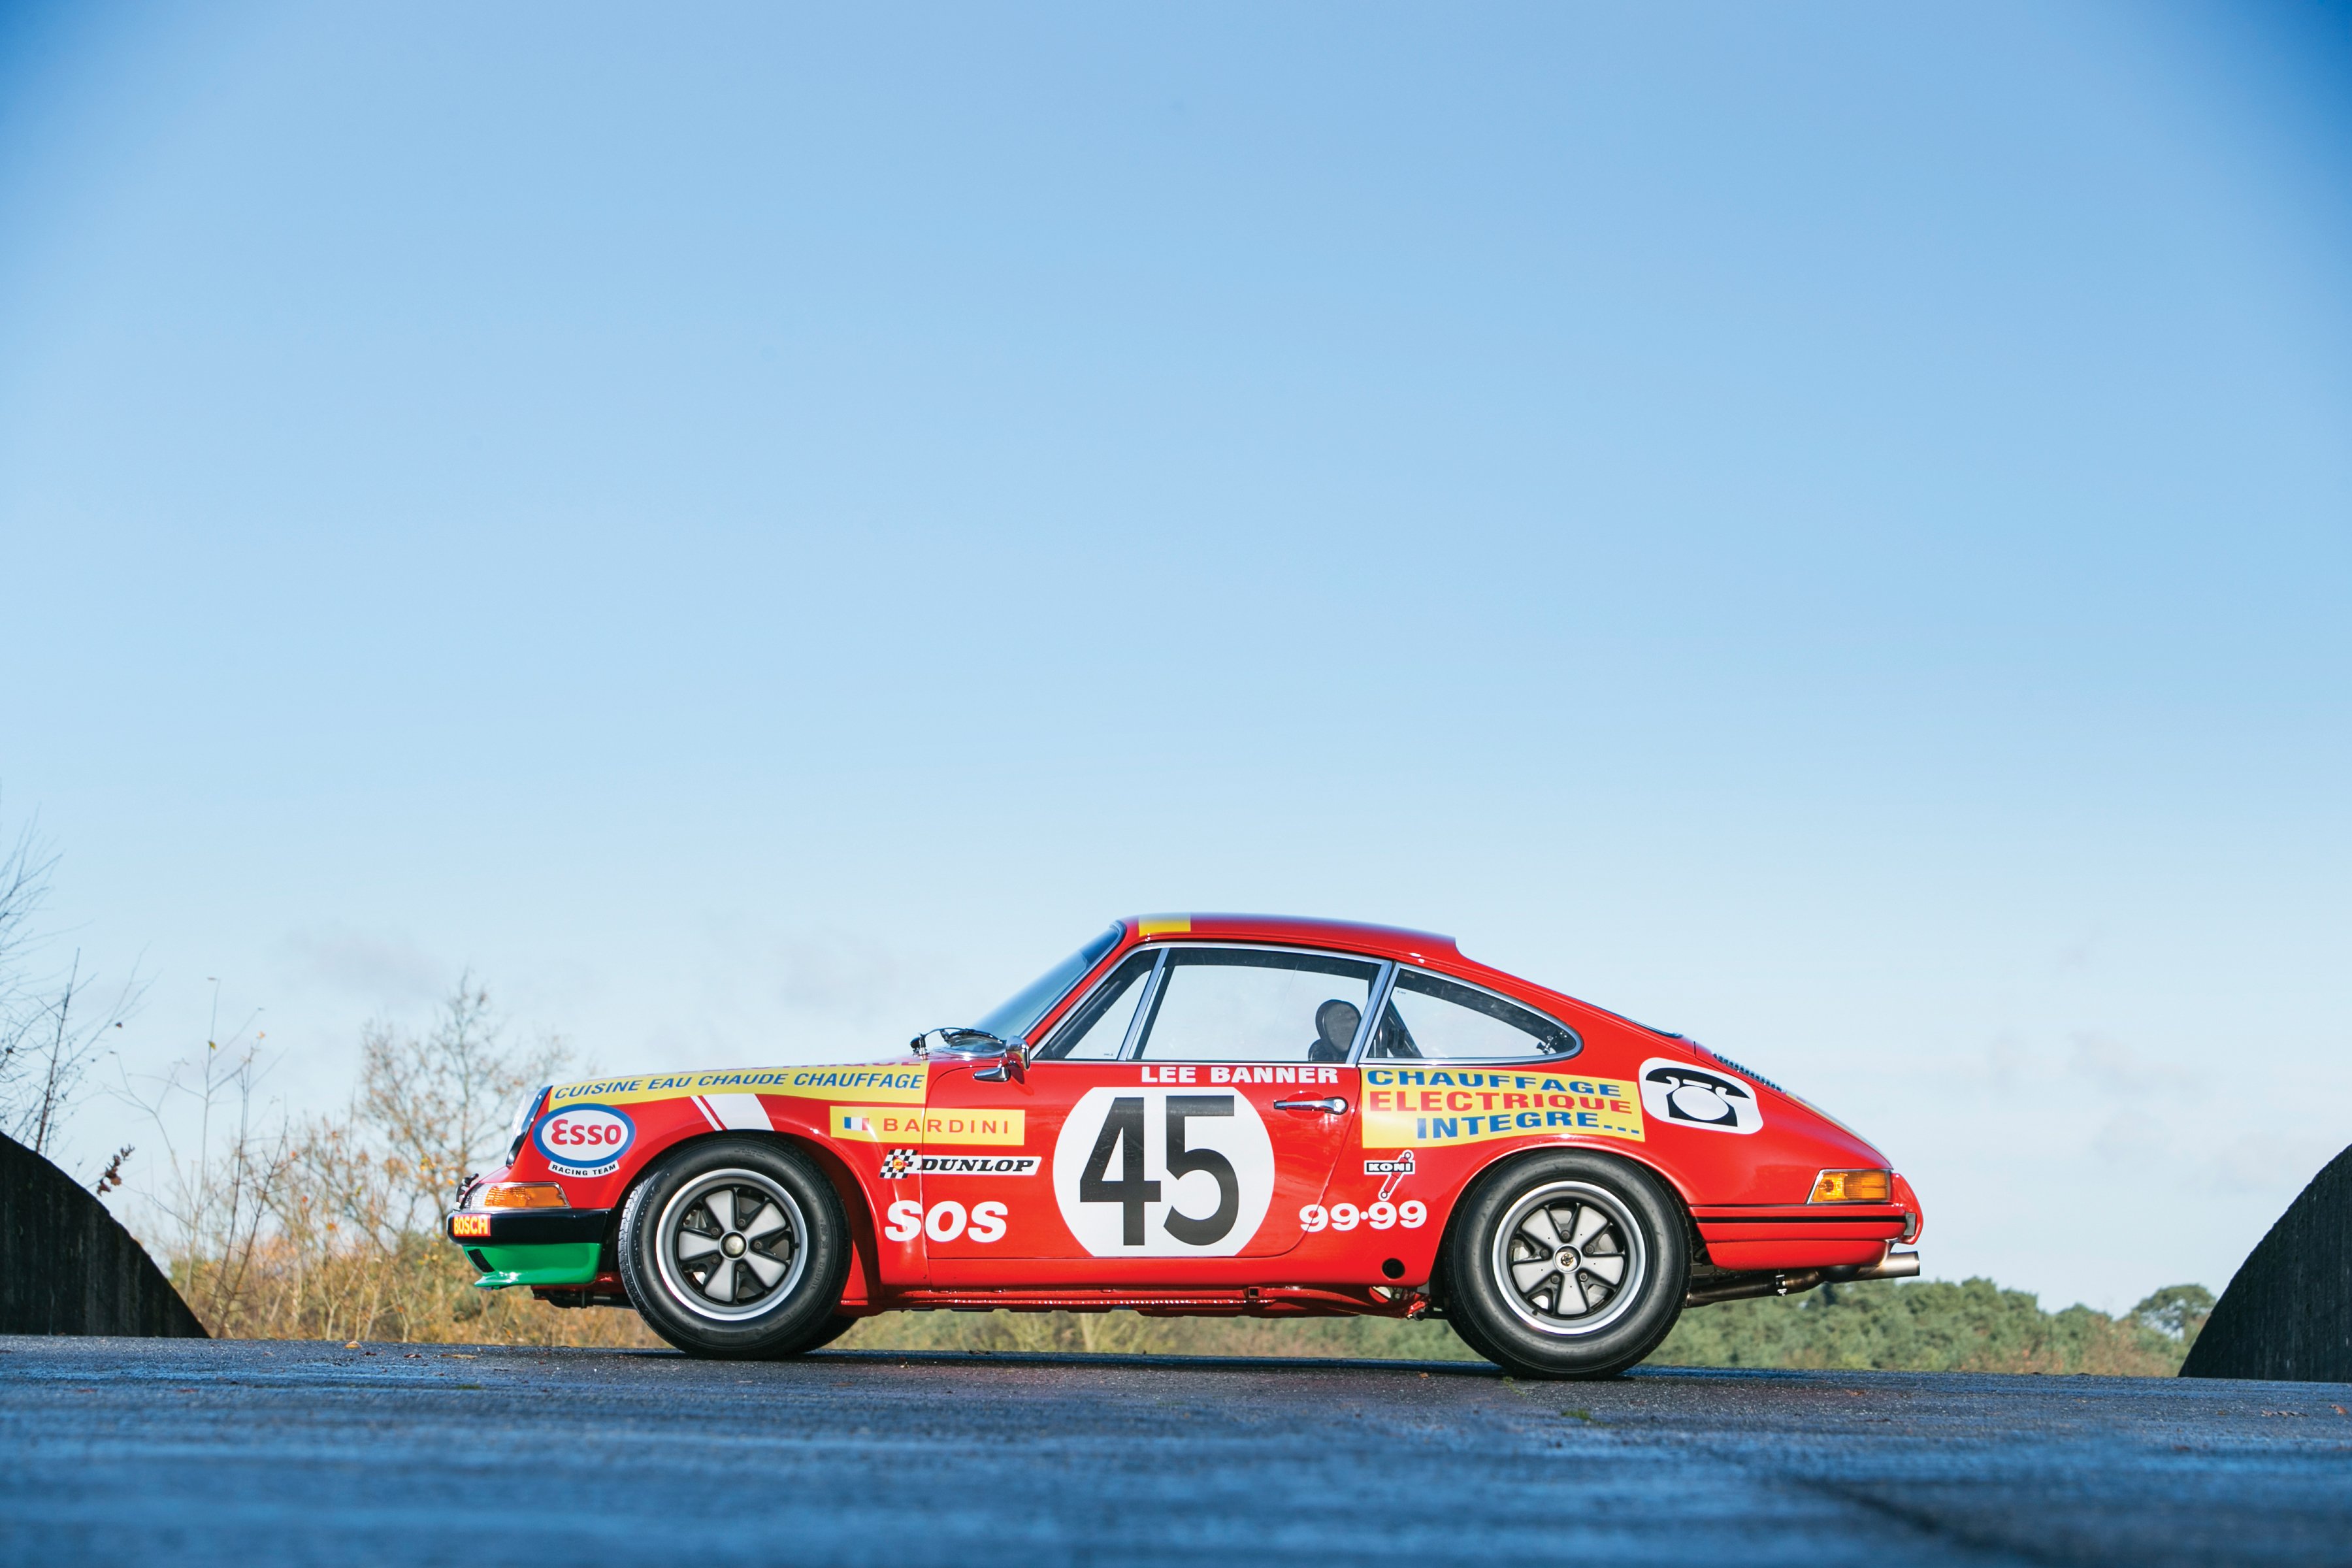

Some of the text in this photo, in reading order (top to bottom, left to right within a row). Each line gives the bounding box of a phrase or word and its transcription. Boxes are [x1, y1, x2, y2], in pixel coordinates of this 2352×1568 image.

[1141, 1066, 1339, 1083] LEE BANNER
[1367, 1070, 1622, 1097] CHAUFFAGE
[555, 1073, 926, 1099] CUISINE EAU CHAUDE CHAUFFAGE
[1369, 1091, 1633, 1114] ELECTRIQUE
[883, 1118, 1009, 1134] BARDINI
[1416, 1111, 1640, 1139] INTEGRE...
[552, 1164, 616, 1175] RACING TEAM
[917, 1158, 1034, 1172] DUNLOP
[1079, 1095, 1239, 1246] 45
[1368, 1163, 1411, 1171] KONI
[453, 1216, 489, 1235] BOSCH
[885, 1200, 1008, 1243] SOS
